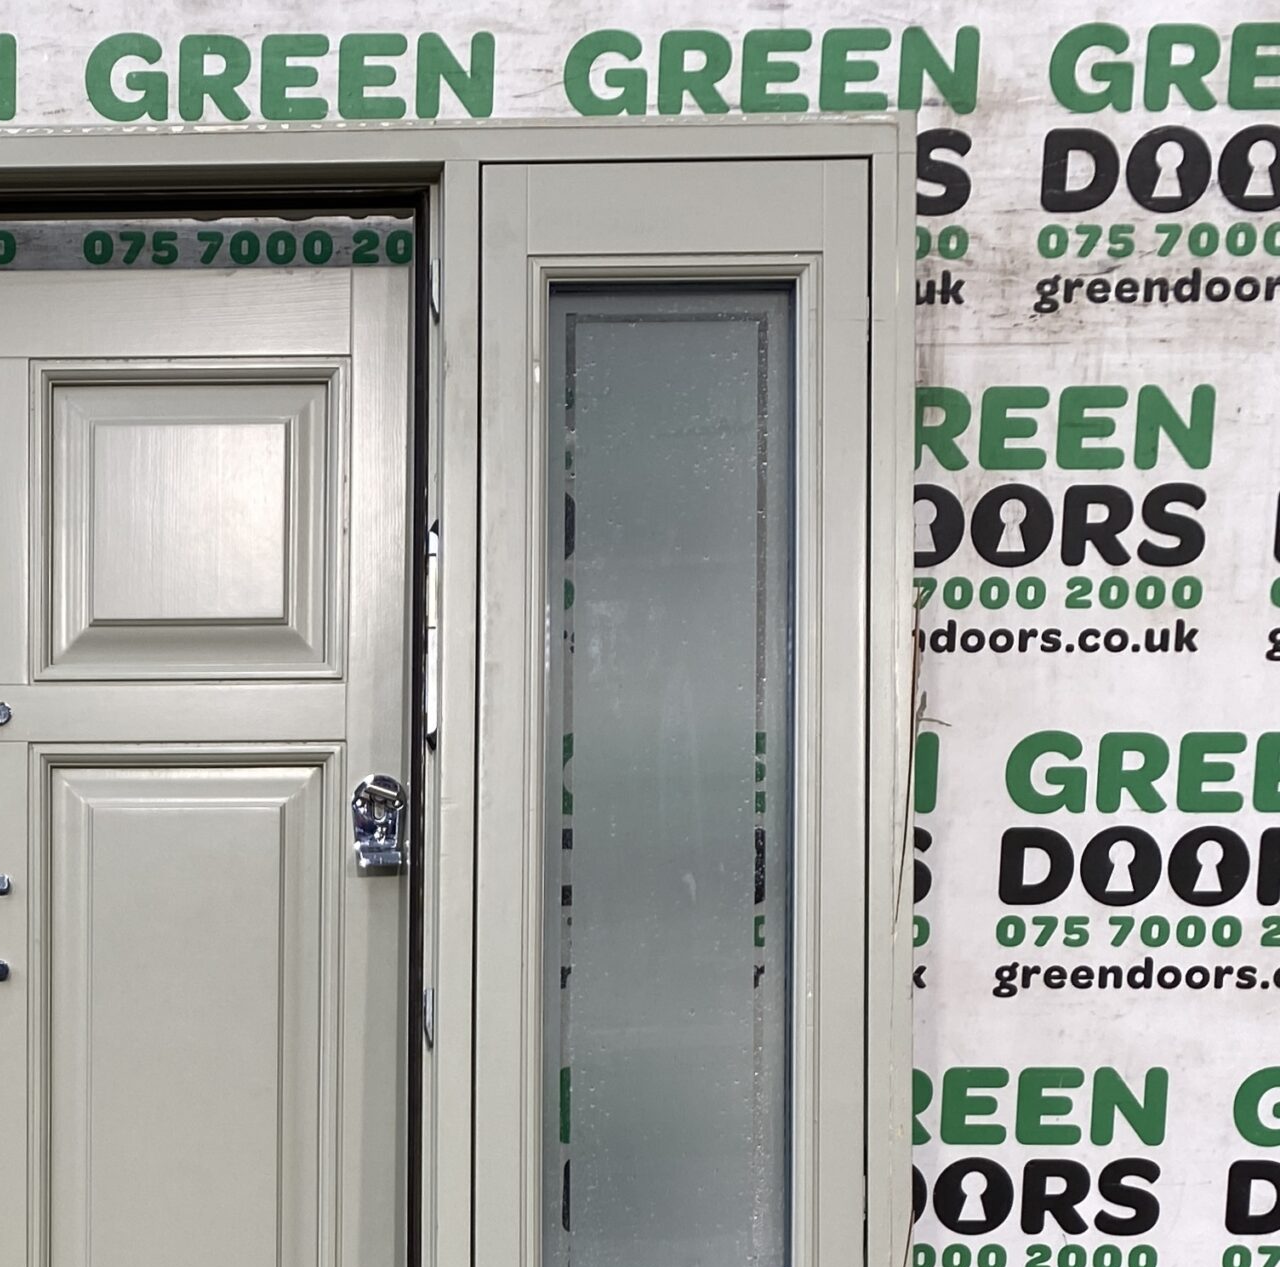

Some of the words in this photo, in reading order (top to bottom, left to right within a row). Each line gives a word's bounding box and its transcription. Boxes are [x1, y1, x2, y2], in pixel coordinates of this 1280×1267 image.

[85, 32, 495, 121] GREEN
[564, 27, 979, 116] GREEN
[1049, 23, 1280, 113] GRE
[83, 230, 178, 264] 075
[198, 230, 332, 263] 7000
[1038, 225, 1134, 259] 075
[915, 384, 1216, 471] REEN
[913, 576, 1046, 610] 7000
[1065, 576, 1202, 609] 2000
[996, 916, 1089, 947] 075
[1109, 916, 1241, 947] 7000
[913, 1157, 1160, 1236] ORS
